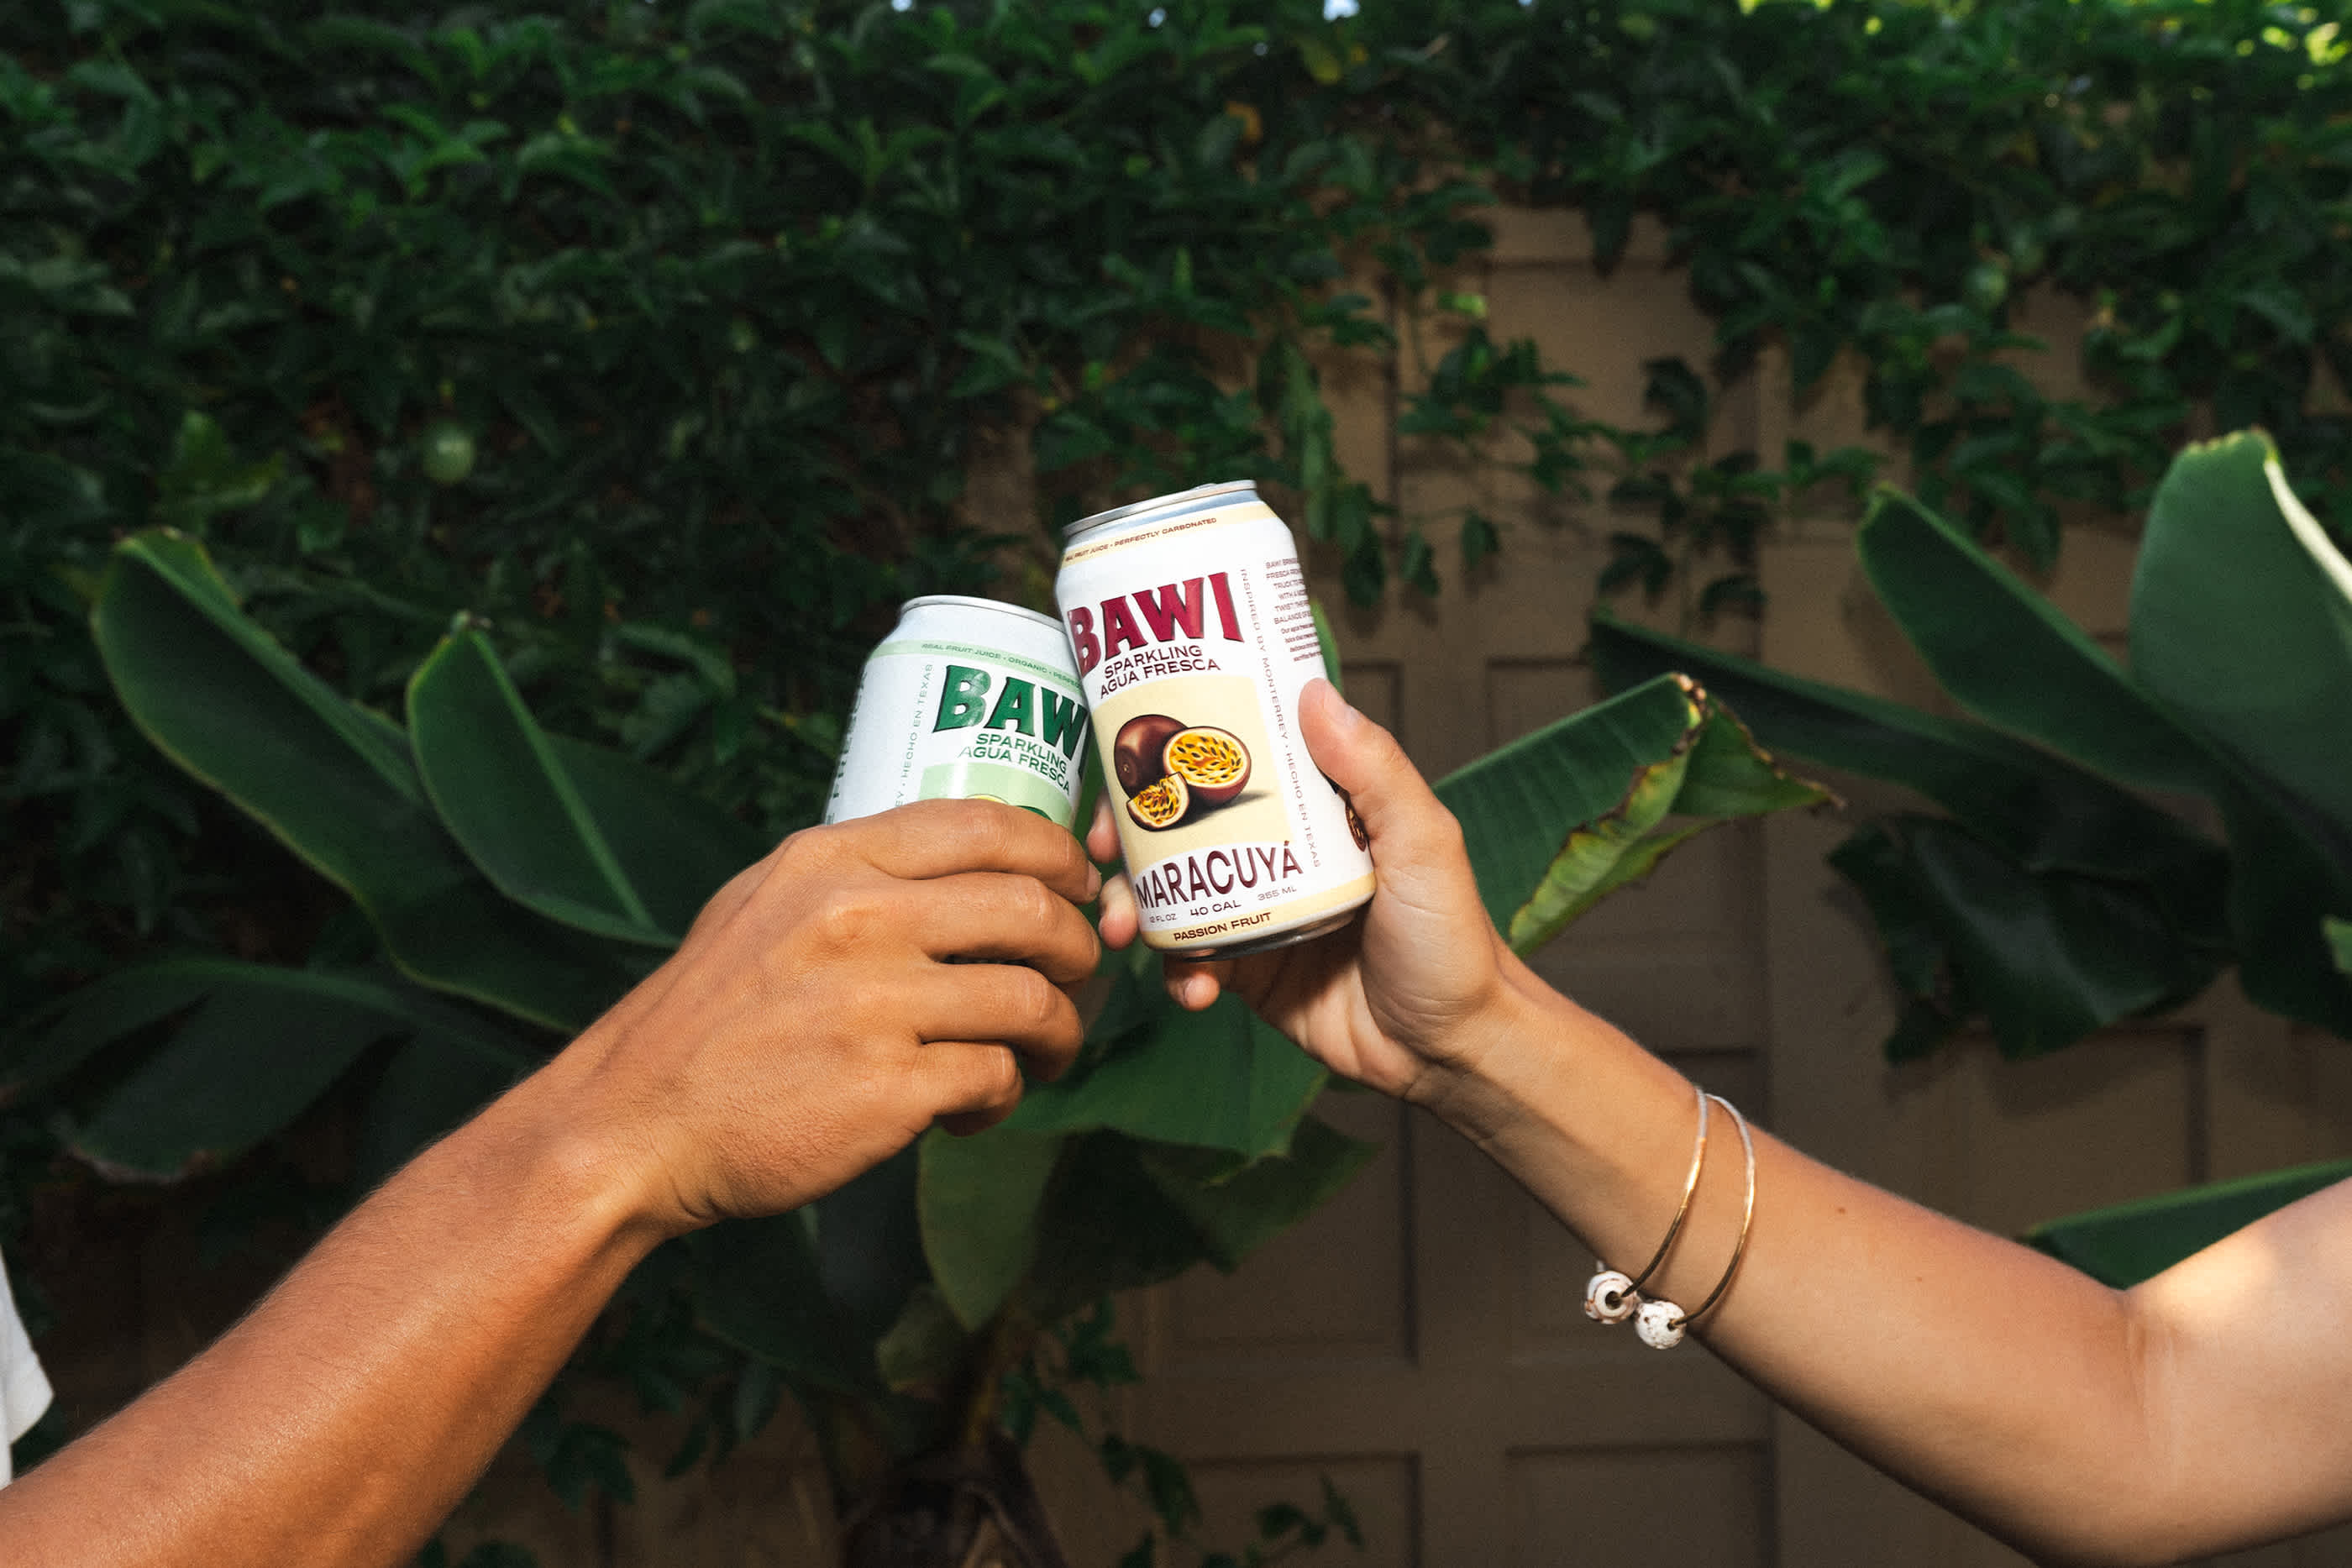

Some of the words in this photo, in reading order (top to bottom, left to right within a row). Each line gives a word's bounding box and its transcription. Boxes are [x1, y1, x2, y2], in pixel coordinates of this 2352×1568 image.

[1114, 530, 1160, 547] PERFECTLY
[1162, 517, 1217, 535] CARBONATED
[1067, 571, 1245, 679] BAWI
[921, 642, 944, 651] REAL
[945, 644, 974, 653] FRUIT
[974, 649, 1001, 660] JUICE
[1007, 656, 1048, 674] ORGANIC
[1104, 644, 1204, 679] SPARKLING
[917, 663, 934, 705] TEXAS
[1100, 670, 1141, 700] AGUA
[1142, 658, 1221, 679] FRESCA
[913, 710, 922, 728] EN
[1240, 569, 1261, 631] INSPIRED
[1256, 636, 1267, 652] BY
[1262, 658, 1289, 740] MONTERREY
[1286, 753, 1303, 800] HECHO
[1299, 803, 1309, 821] EN
[1305, 826, 1321, 868] TEXAS
[900, 732, 918, 779] HECHO
[957, 745, 1013, 763] AGUA
[1018, 753, 1070, 796] FRESCA
[975, 732, 1068, 774] SPARKLING
[1135, 840, 1305, 910] MARACUYÁ
[1257, 889, 1280, 901] 355
[1281, 885, 1298, 896] ML
[1165, 913, 1177, 922] OZ
[1173, 923, 1228, 941] PASSION
[1230, 911, 1272, 930] FRUIT
[1189, 906, 1209, 918] 40
[1212, 899, 1242, 914] CAL
